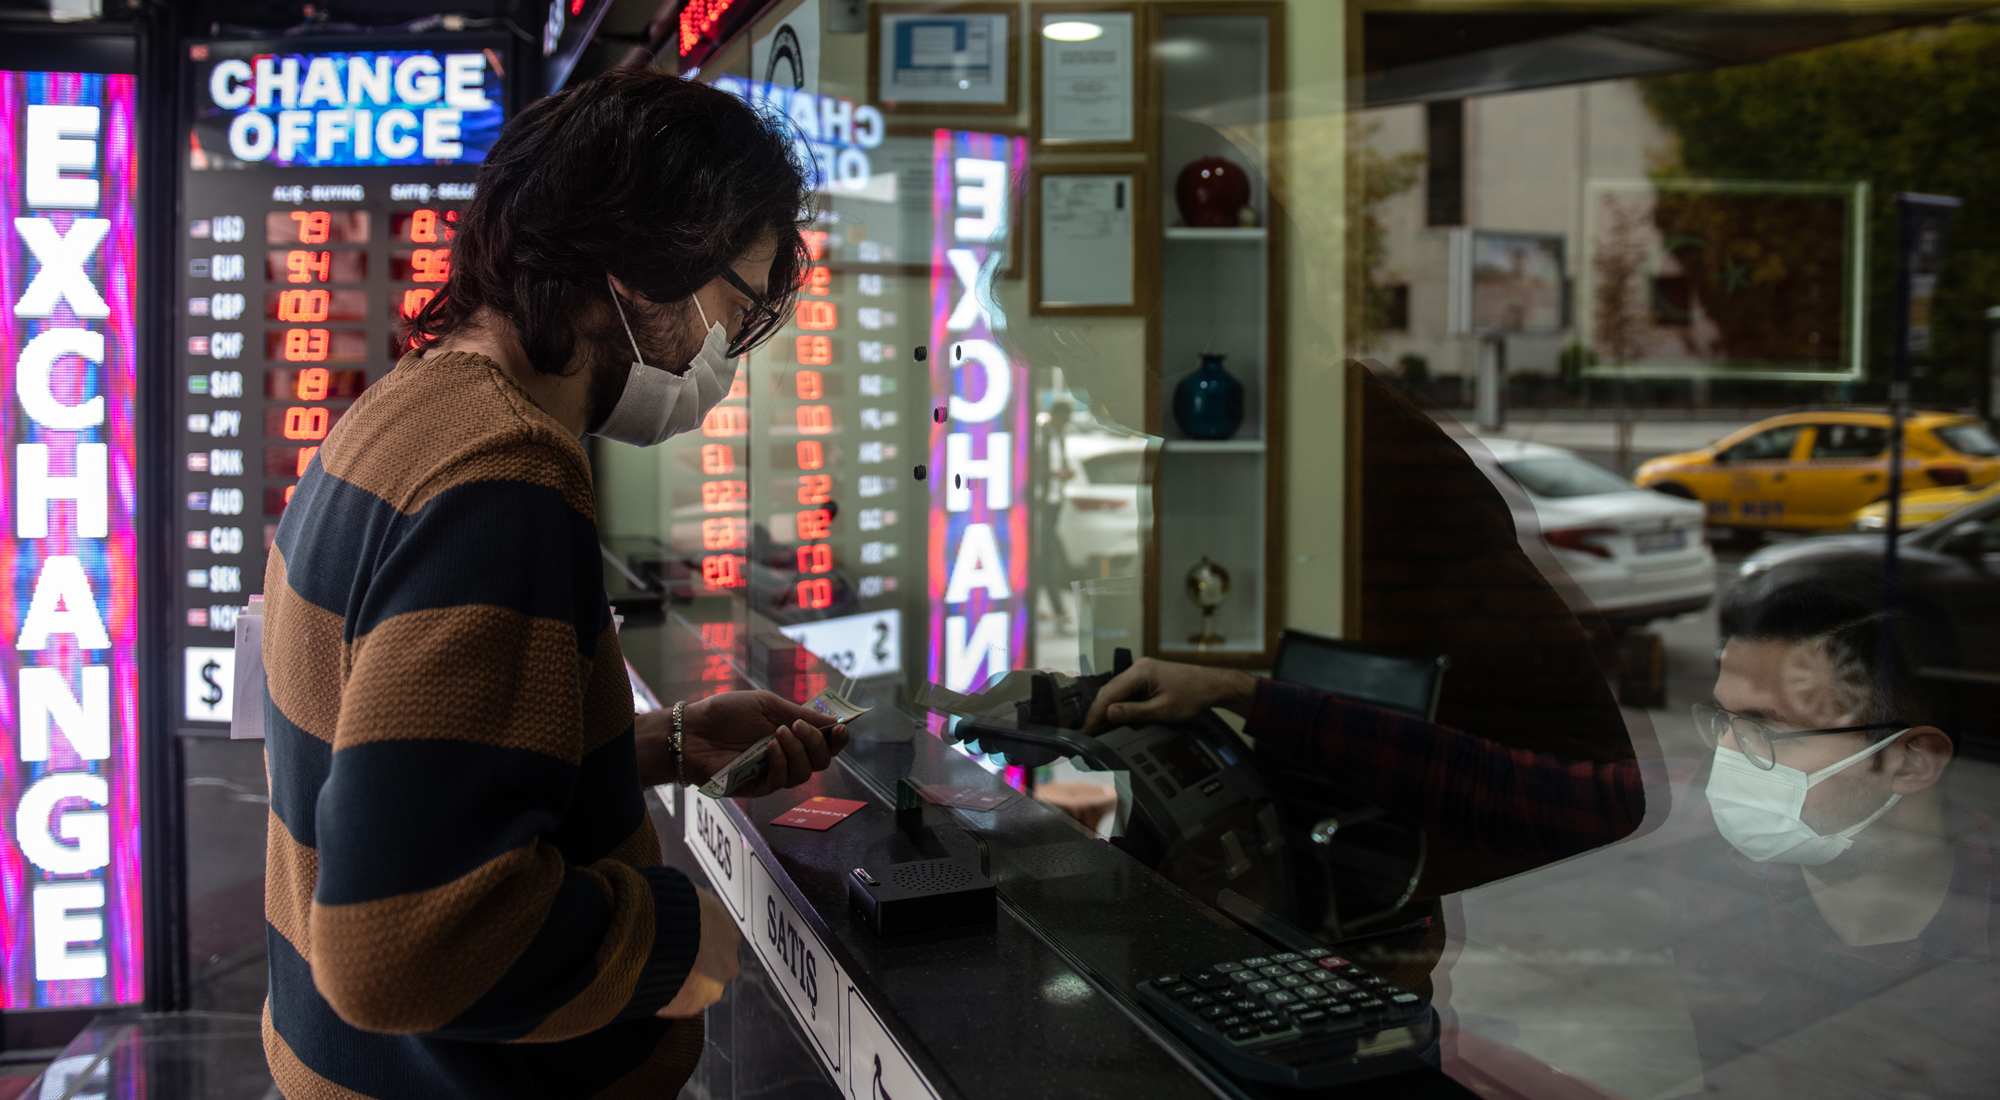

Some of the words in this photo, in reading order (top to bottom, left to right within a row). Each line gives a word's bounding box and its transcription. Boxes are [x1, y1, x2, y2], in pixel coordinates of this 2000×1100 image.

[209, 54, 487, 109] CHANGE
[228, 108, 462, 162] OFFICE
[211, 216, 245, 242] USD
[211, 255, 244, 281] EUR
[209, 410, 241, 437] JPY
[209, 488, 243, 515] AUD
[14, 104, 112, 982] EXCHANGE
[209, 527, 243, 554] CAD
[200, 660, 223, 710] $
[791, 807, 849, 817] AKBANK
[696, 797, 732, 881] SALES
[767, 895, 818, 1021] SATIŞ
[1246, 957, 1267, 965] 000
[1275, 992, 1288, 1001] 9
[1304, 986, 1318, 995] 8
